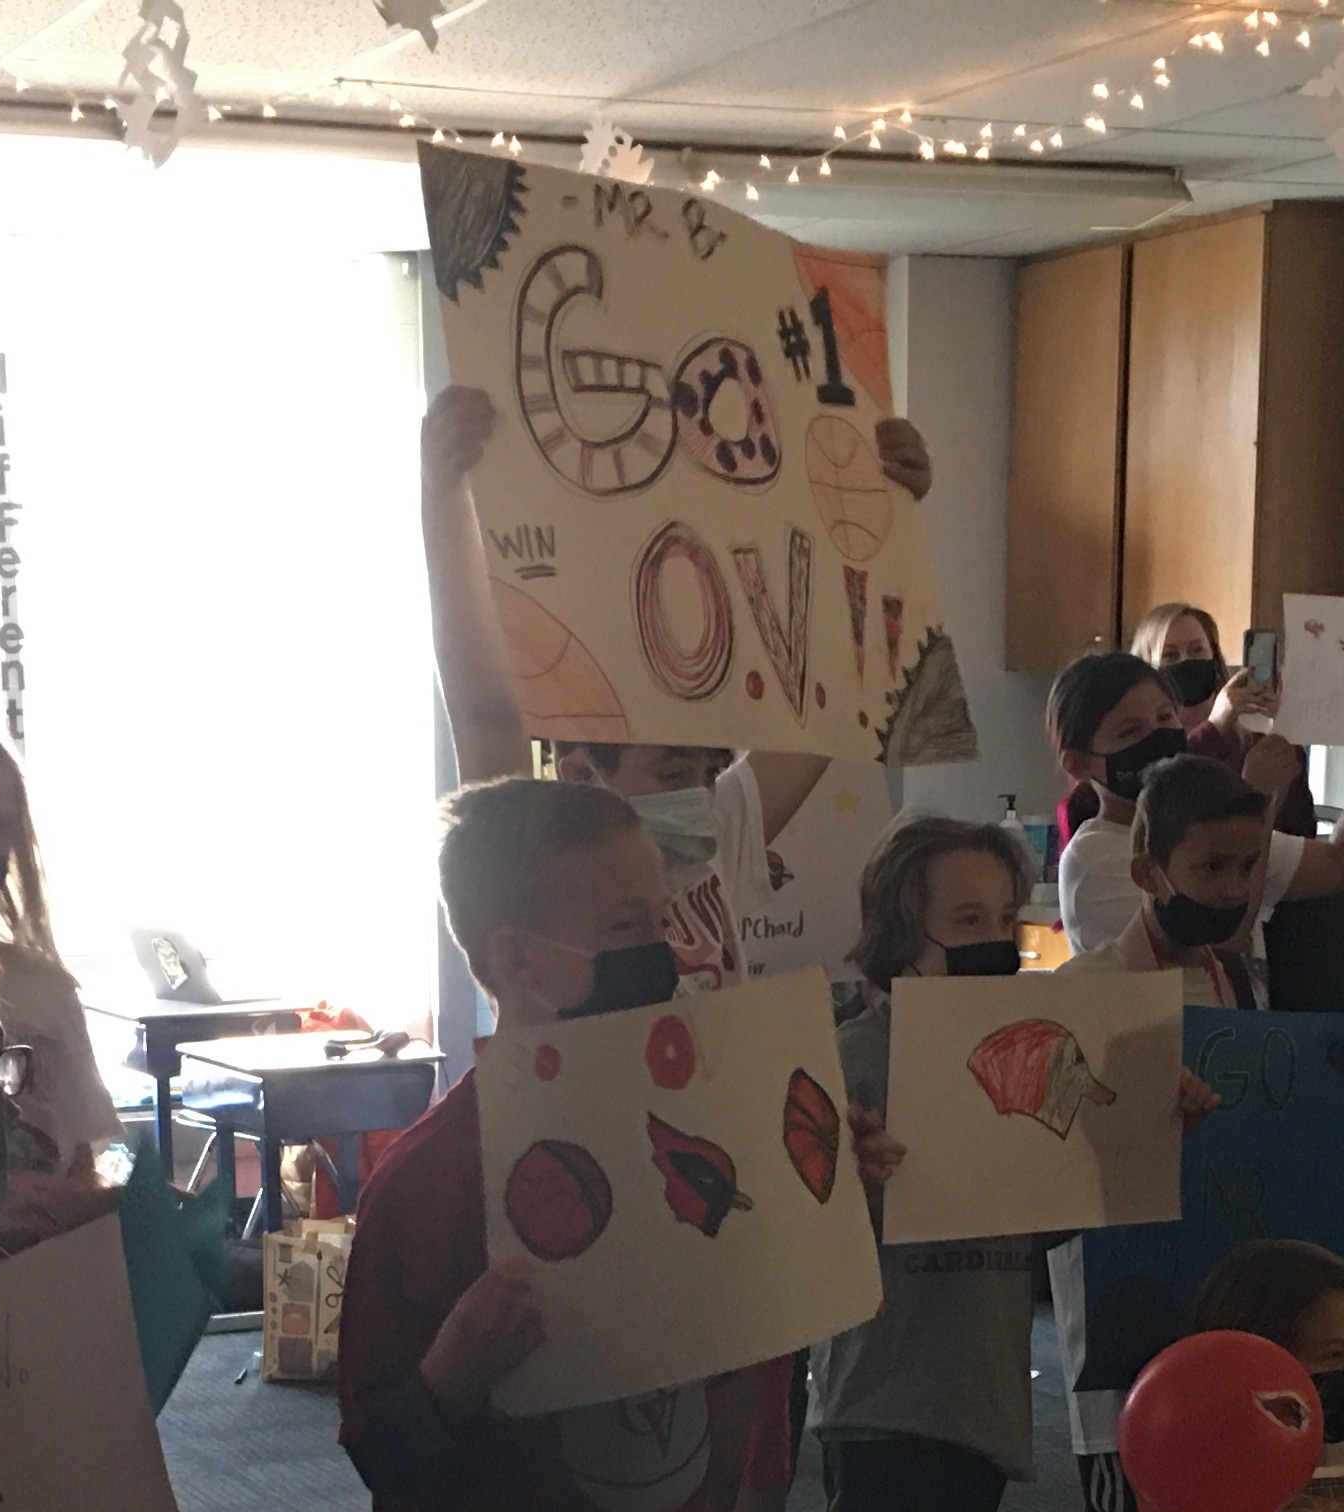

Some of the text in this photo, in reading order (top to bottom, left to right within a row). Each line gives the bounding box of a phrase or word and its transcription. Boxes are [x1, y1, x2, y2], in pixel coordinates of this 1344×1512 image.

[776, 286, 858, 409] #1
[488, 523, 557, 560] WIN
[1197, 1026, 1297, 1112] GO
